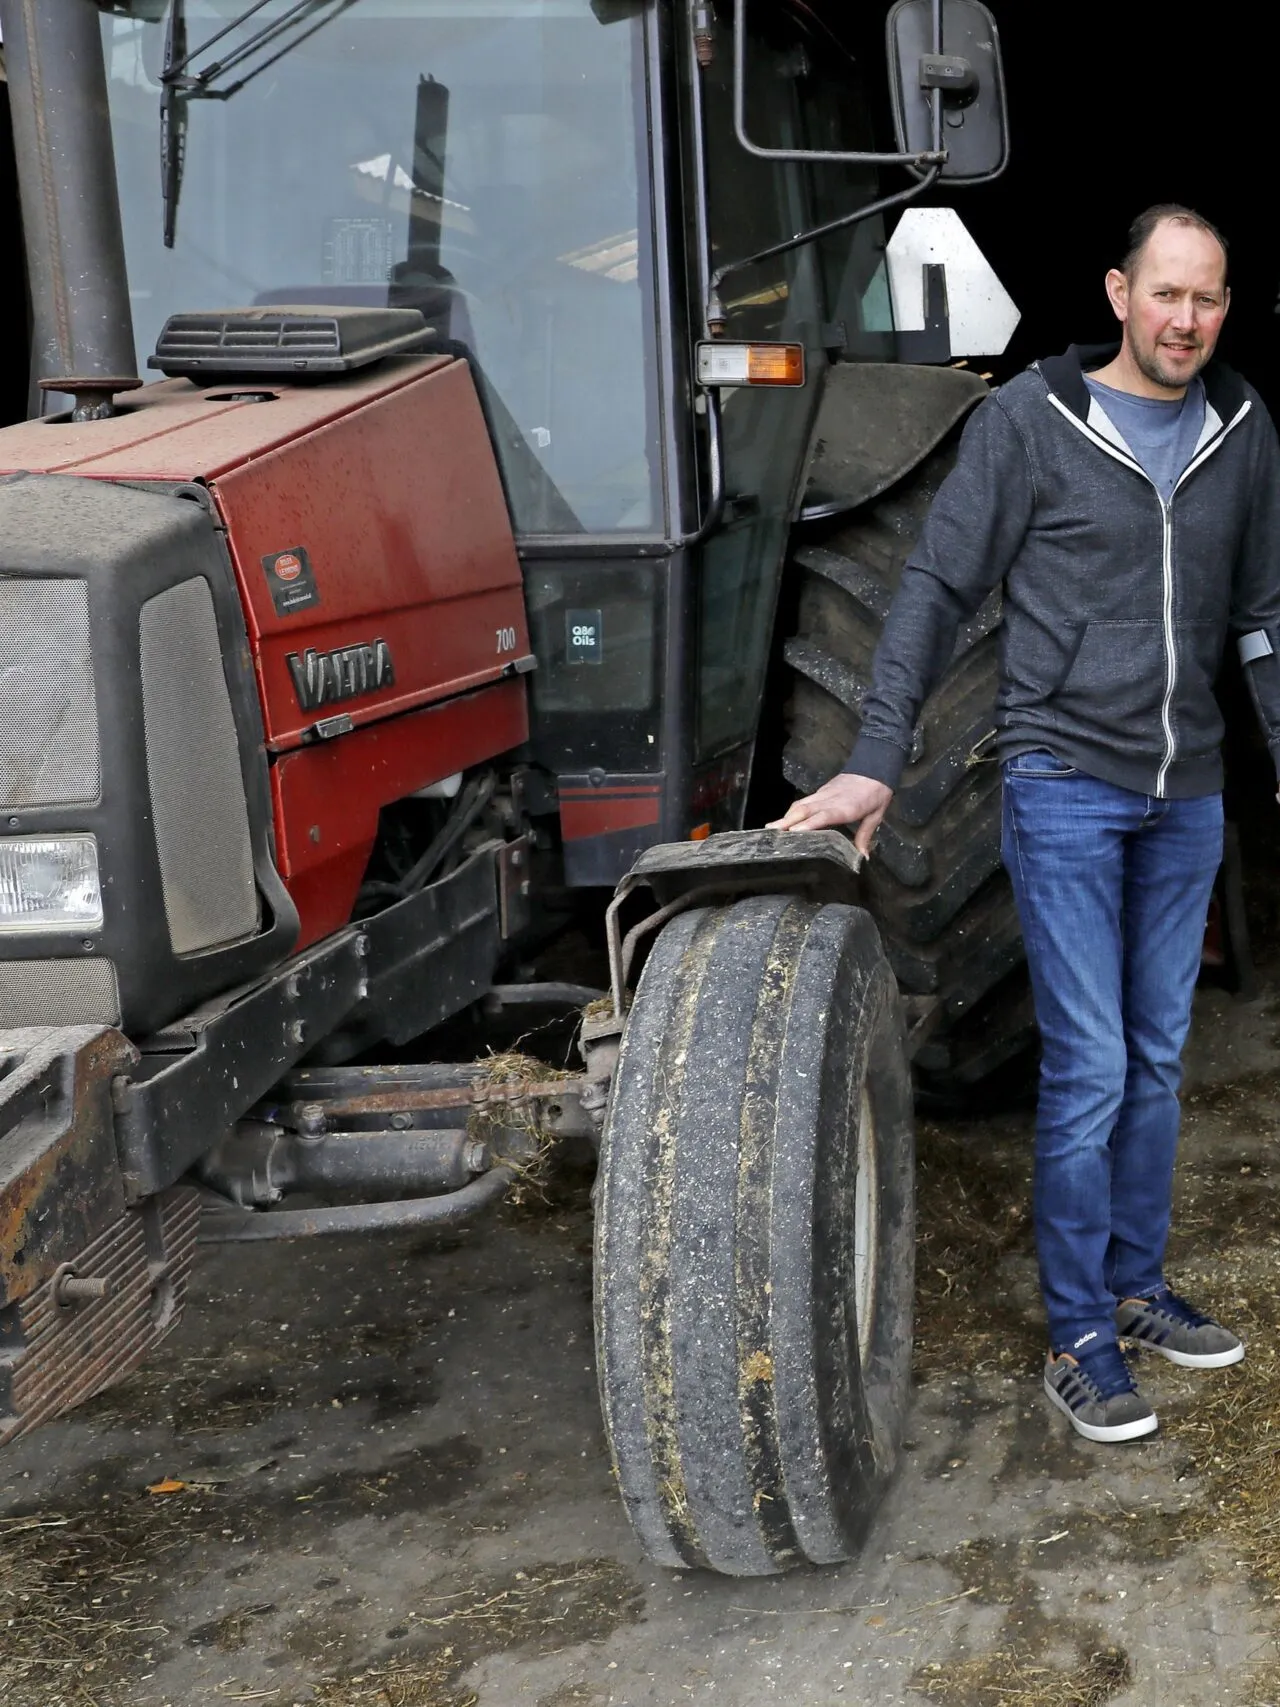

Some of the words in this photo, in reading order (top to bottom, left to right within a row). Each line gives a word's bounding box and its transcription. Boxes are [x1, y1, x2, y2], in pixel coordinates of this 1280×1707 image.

[495, 627, 516, 654] 700
[572, 636, 595, 646] Oils
[287, 641, 393, 711] VALTRA
[1074, 1331, 1098, 1349] adidas
